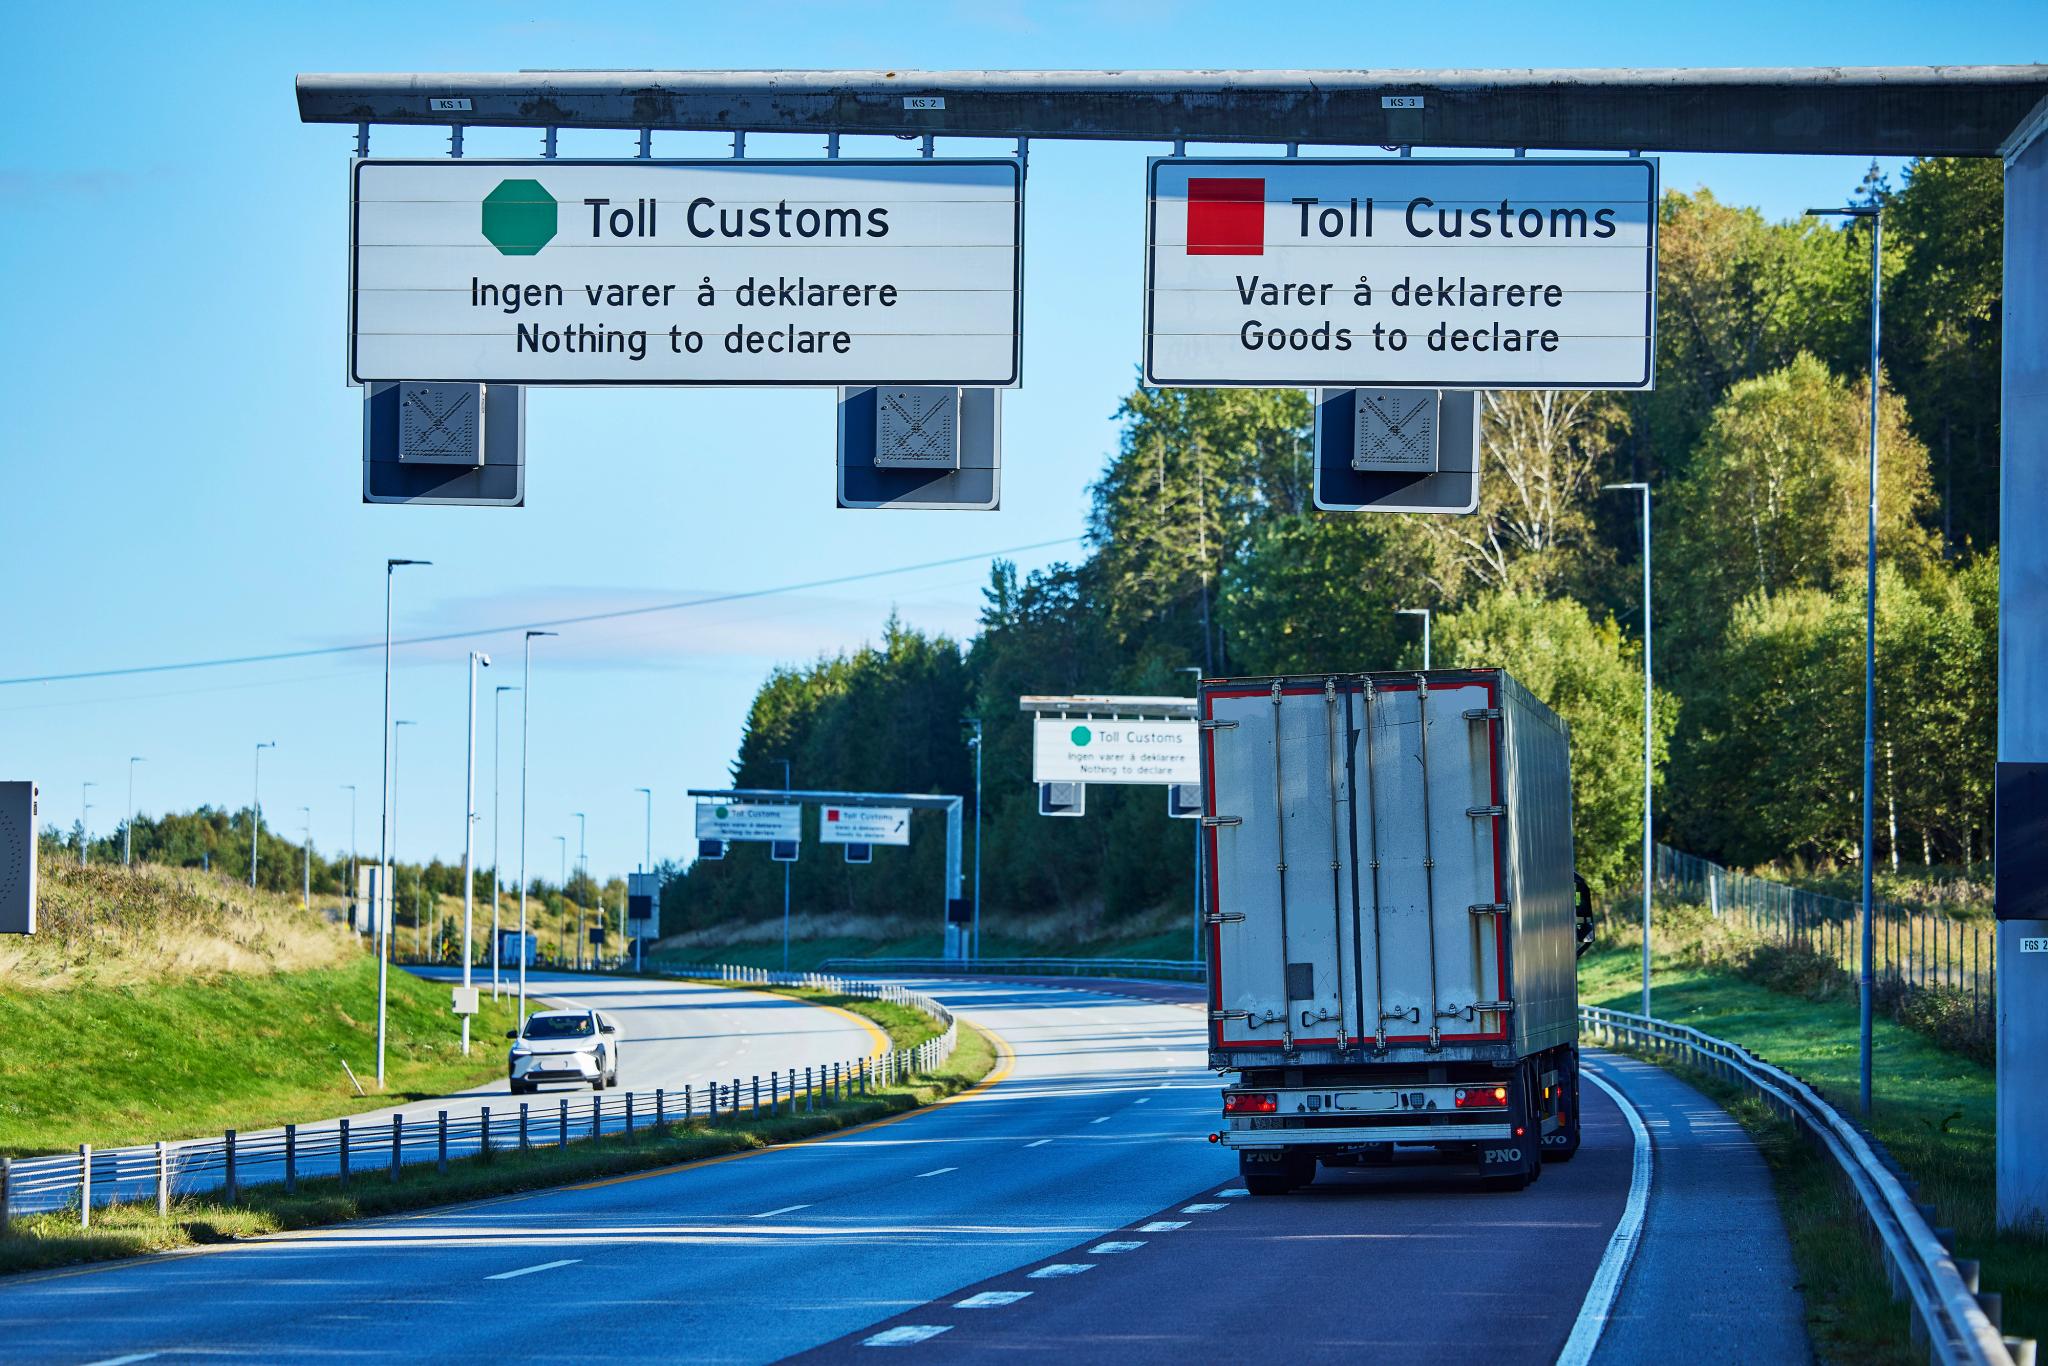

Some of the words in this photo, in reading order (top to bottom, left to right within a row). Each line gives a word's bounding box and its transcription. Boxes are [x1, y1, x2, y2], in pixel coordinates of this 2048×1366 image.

[440, 100, 453, 108] KS
[457, 100, 463, 108] 1
[912, 99, 925, 107] KS
[930, 99, 937, 107] 2
[1390, 98, 1404, 106] KS
[1409, 98, 1415, 106] 3
[584, 199, 656, 238] Toll
[687, 197, 889, 239] Customs
[1291, 197, 1373, 238] Toll
[1405, 197, 1617, 239] Customs
[472, 277, 563, 315] Ingen
[585, 284, 676, 307] varer
[698, 276, 714, 307] å
[735, 276, 899, 307] deklarere
[1236, 275, 1334, 306] Varer
[1354, 275, 1372, 306] å
[1391, 276, 1563, 308] deklarere
[516, 323, 648, 361] Nothing
[669, 325, 704, 354] to
[724, 323, 851, 354] declare
[1241, 320, 1353, 352] Goods
[1373, 322, 1408, 352] to
[1427, 321, 1560, 353] declare
[1099, 731, 1120, 743] Toll
[1126, 731, 1183, 744] Customs
[2024, 940, 2039, 951] FGS
[1484, 1148, 1521, 1164] PNO
